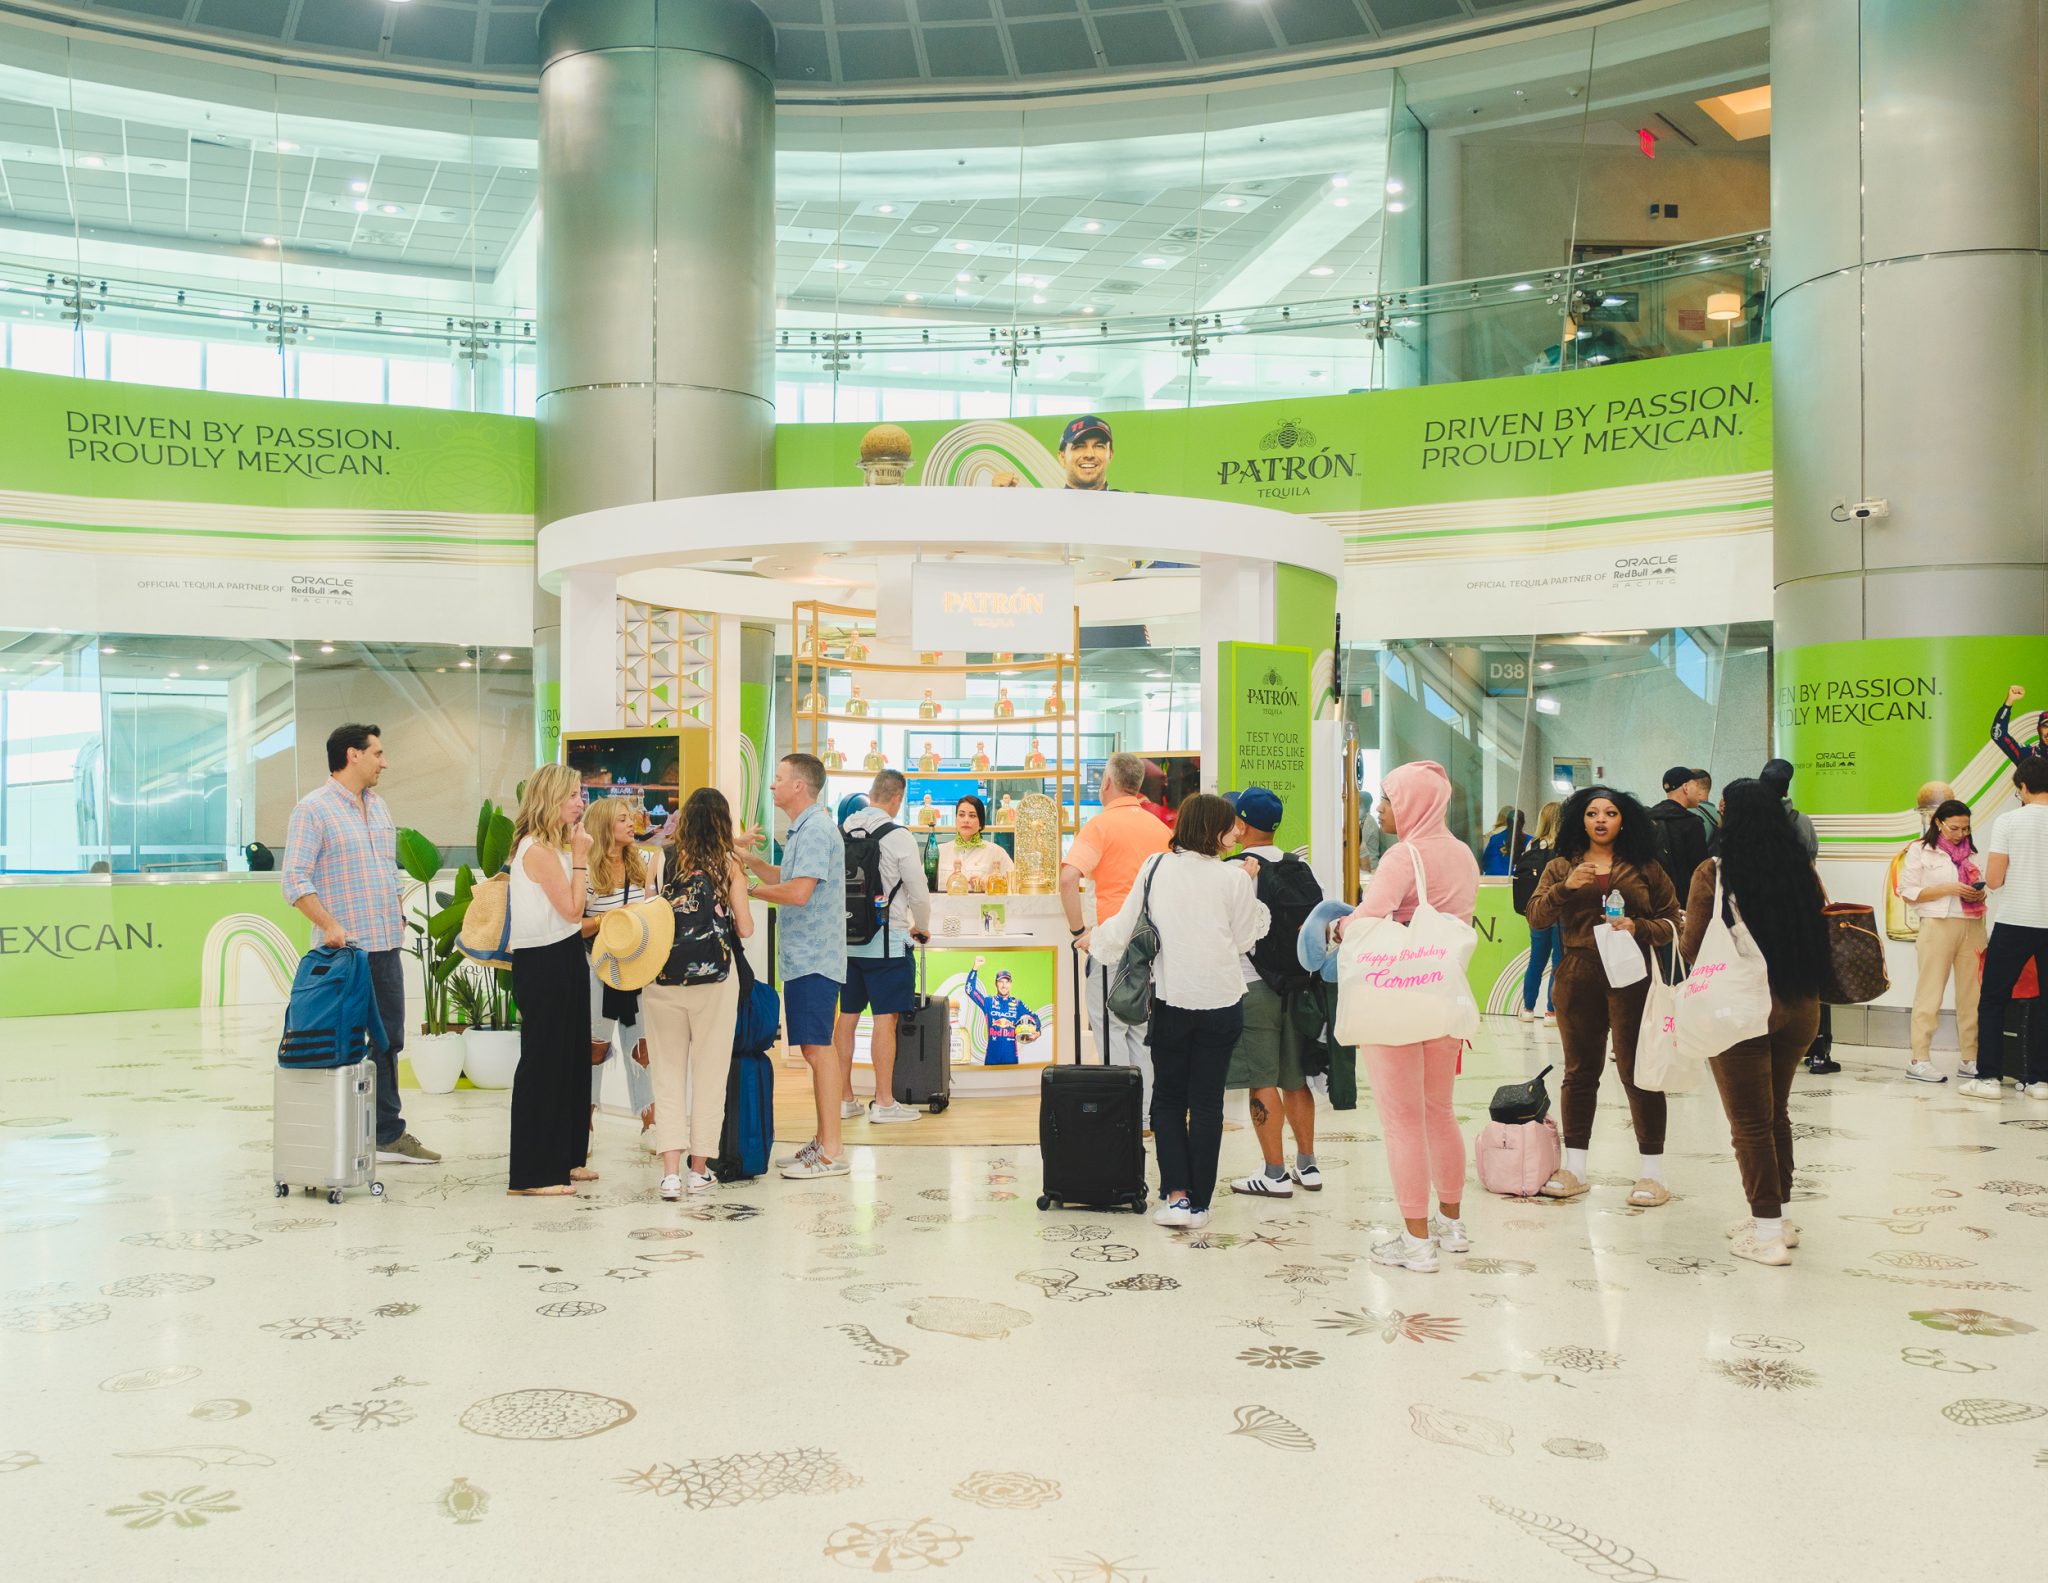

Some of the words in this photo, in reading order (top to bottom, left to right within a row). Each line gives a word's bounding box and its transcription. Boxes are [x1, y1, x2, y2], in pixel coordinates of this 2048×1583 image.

[1423, 412, 1545, 443] DRIVEN
[1554, 405, 1594, 431] BY
[1605, 381, 1760, 425] PASSION.
[65, 410, 192, 441] DRIVEN
[203, 422, 244, 444] BY
[256, 425, 400, 450] PASSION.
[1421, 435, 1574, 470] PROUDLY
[1583, 414, 1744, 455] MEXICAN.
[68, 438, 226, 469] PROUDLY
[237, 450, 390, 479] MEXICAN.
[1217, 446, 1358, 486] PATRÓN
[1257, 486, 1311, 500] TEQUILA
[1615, 554, 1678, 568] ORACLE
[137, 580, 180, 589] OFFICIAL
[184, 581, 224, 589] TEQUILA
[226, 582, 270, 592] PARTNER
[291, 575, 354, 587] ORACLE
[1467, 580, 1507, 590] OFFICIAL
[1509, 578, 1548, 588] TEQUILA
[1550, 574, 1592, 585] PARTNER
[1594, 573, 1607, 581] OF
[1490, 663, 1525, 680] D38
[1247, 686, 1299, 706] PATRÓN
[1799, 683, 1821, 703] BY
[1827, 677, 1943, 700] PASSION.
[1263, 708, 1283, 716] TEQUILA
[1777, 706, 1810, 728] UDLY
[1816, 701, 1932, 726] MEXICAN.
[1246, 731, 1269, 743] TEST
[1272, 732, 1299, 744] YOUR
[1239, 745, 1284, 757] REFLEXES
[1286, 747, 1305, 758] LIKE
[1816, 752, 1856, 760] ORACLE
[1240, 759, 1254, 770] AN
[1267, 760, 1304, 771] MASTER
[1273, 781, 1283, 790] BE
[0, 922, 163, 959] EXICAN.
[1356, 951, 1397, 967] Happy
[1400, 944, 1449, 962] Birthday
[1365, 968, 1444, 988] Carmen
